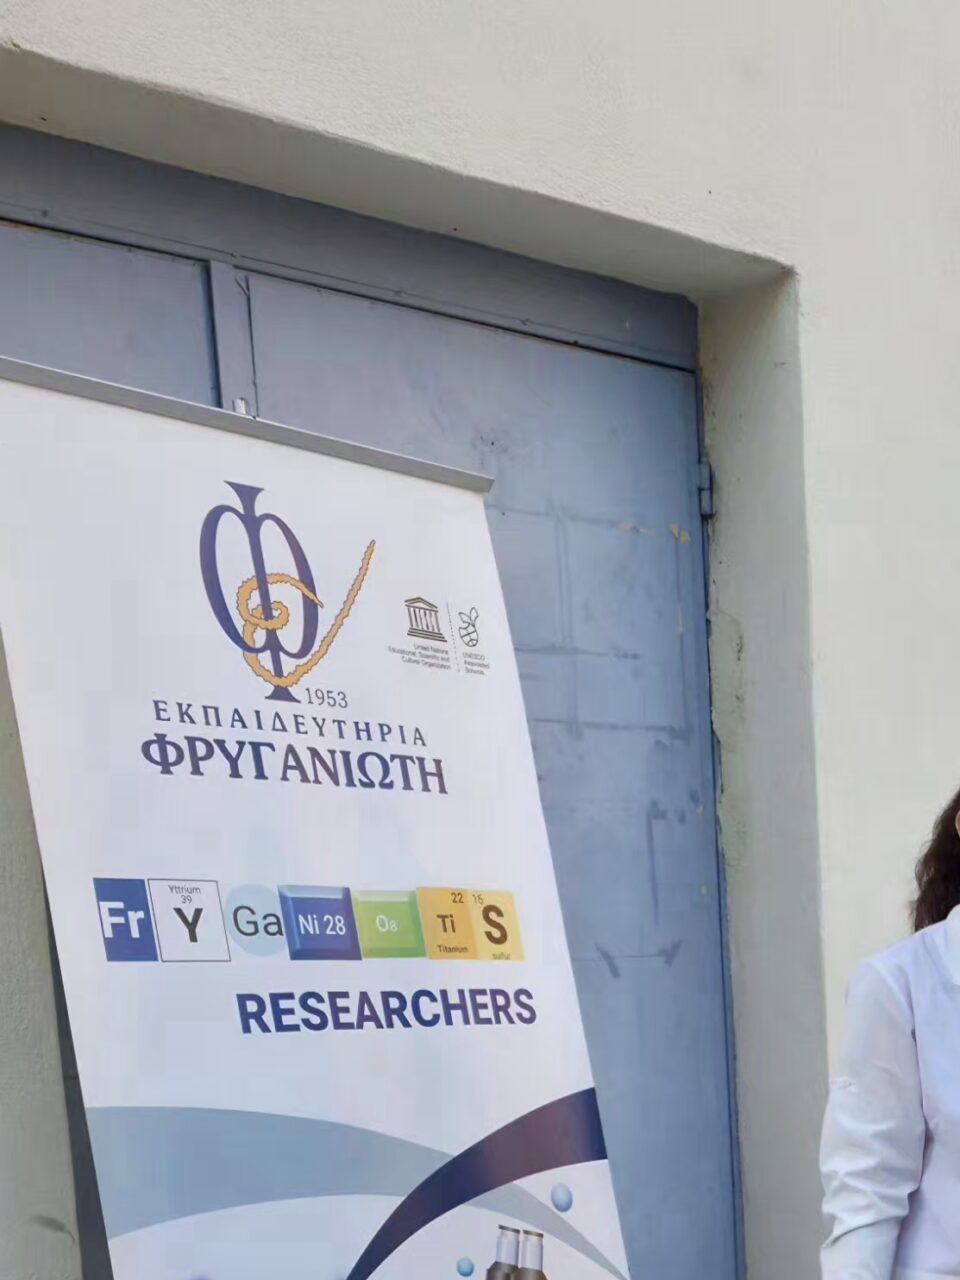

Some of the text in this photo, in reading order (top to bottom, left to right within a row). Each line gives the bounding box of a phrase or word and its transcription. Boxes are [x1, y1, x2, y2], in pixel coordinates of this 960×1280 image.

[305, 687, 349, 709] 1953
[152, 699, 427, 747] ΕΚΠΑΙΔΕΥΤΗΡΙΑ
[141, 732, 448, 794] ΦΡΥΓΑΝΙΩΤΗ
[168, 884, 202, 895] Yttrium
[451, 892, 464, 904] 22
[181, 895, 193, 904] 39
[472, 894, 484, 906] 16
[99, 901, 145, 938] Fr
[173, 907, 203, 943] Y
[232, 905, 284, 937] Ga
[298, 914, 320, 935] Ni
[323, 915, 346, 935] 28
[436, 914, 456, 933] Ti
[482, 904, 508, 946] S
[437, 944, 469, 953] Titanium
[235, 988, 538, 1035] RESEARCHERS
